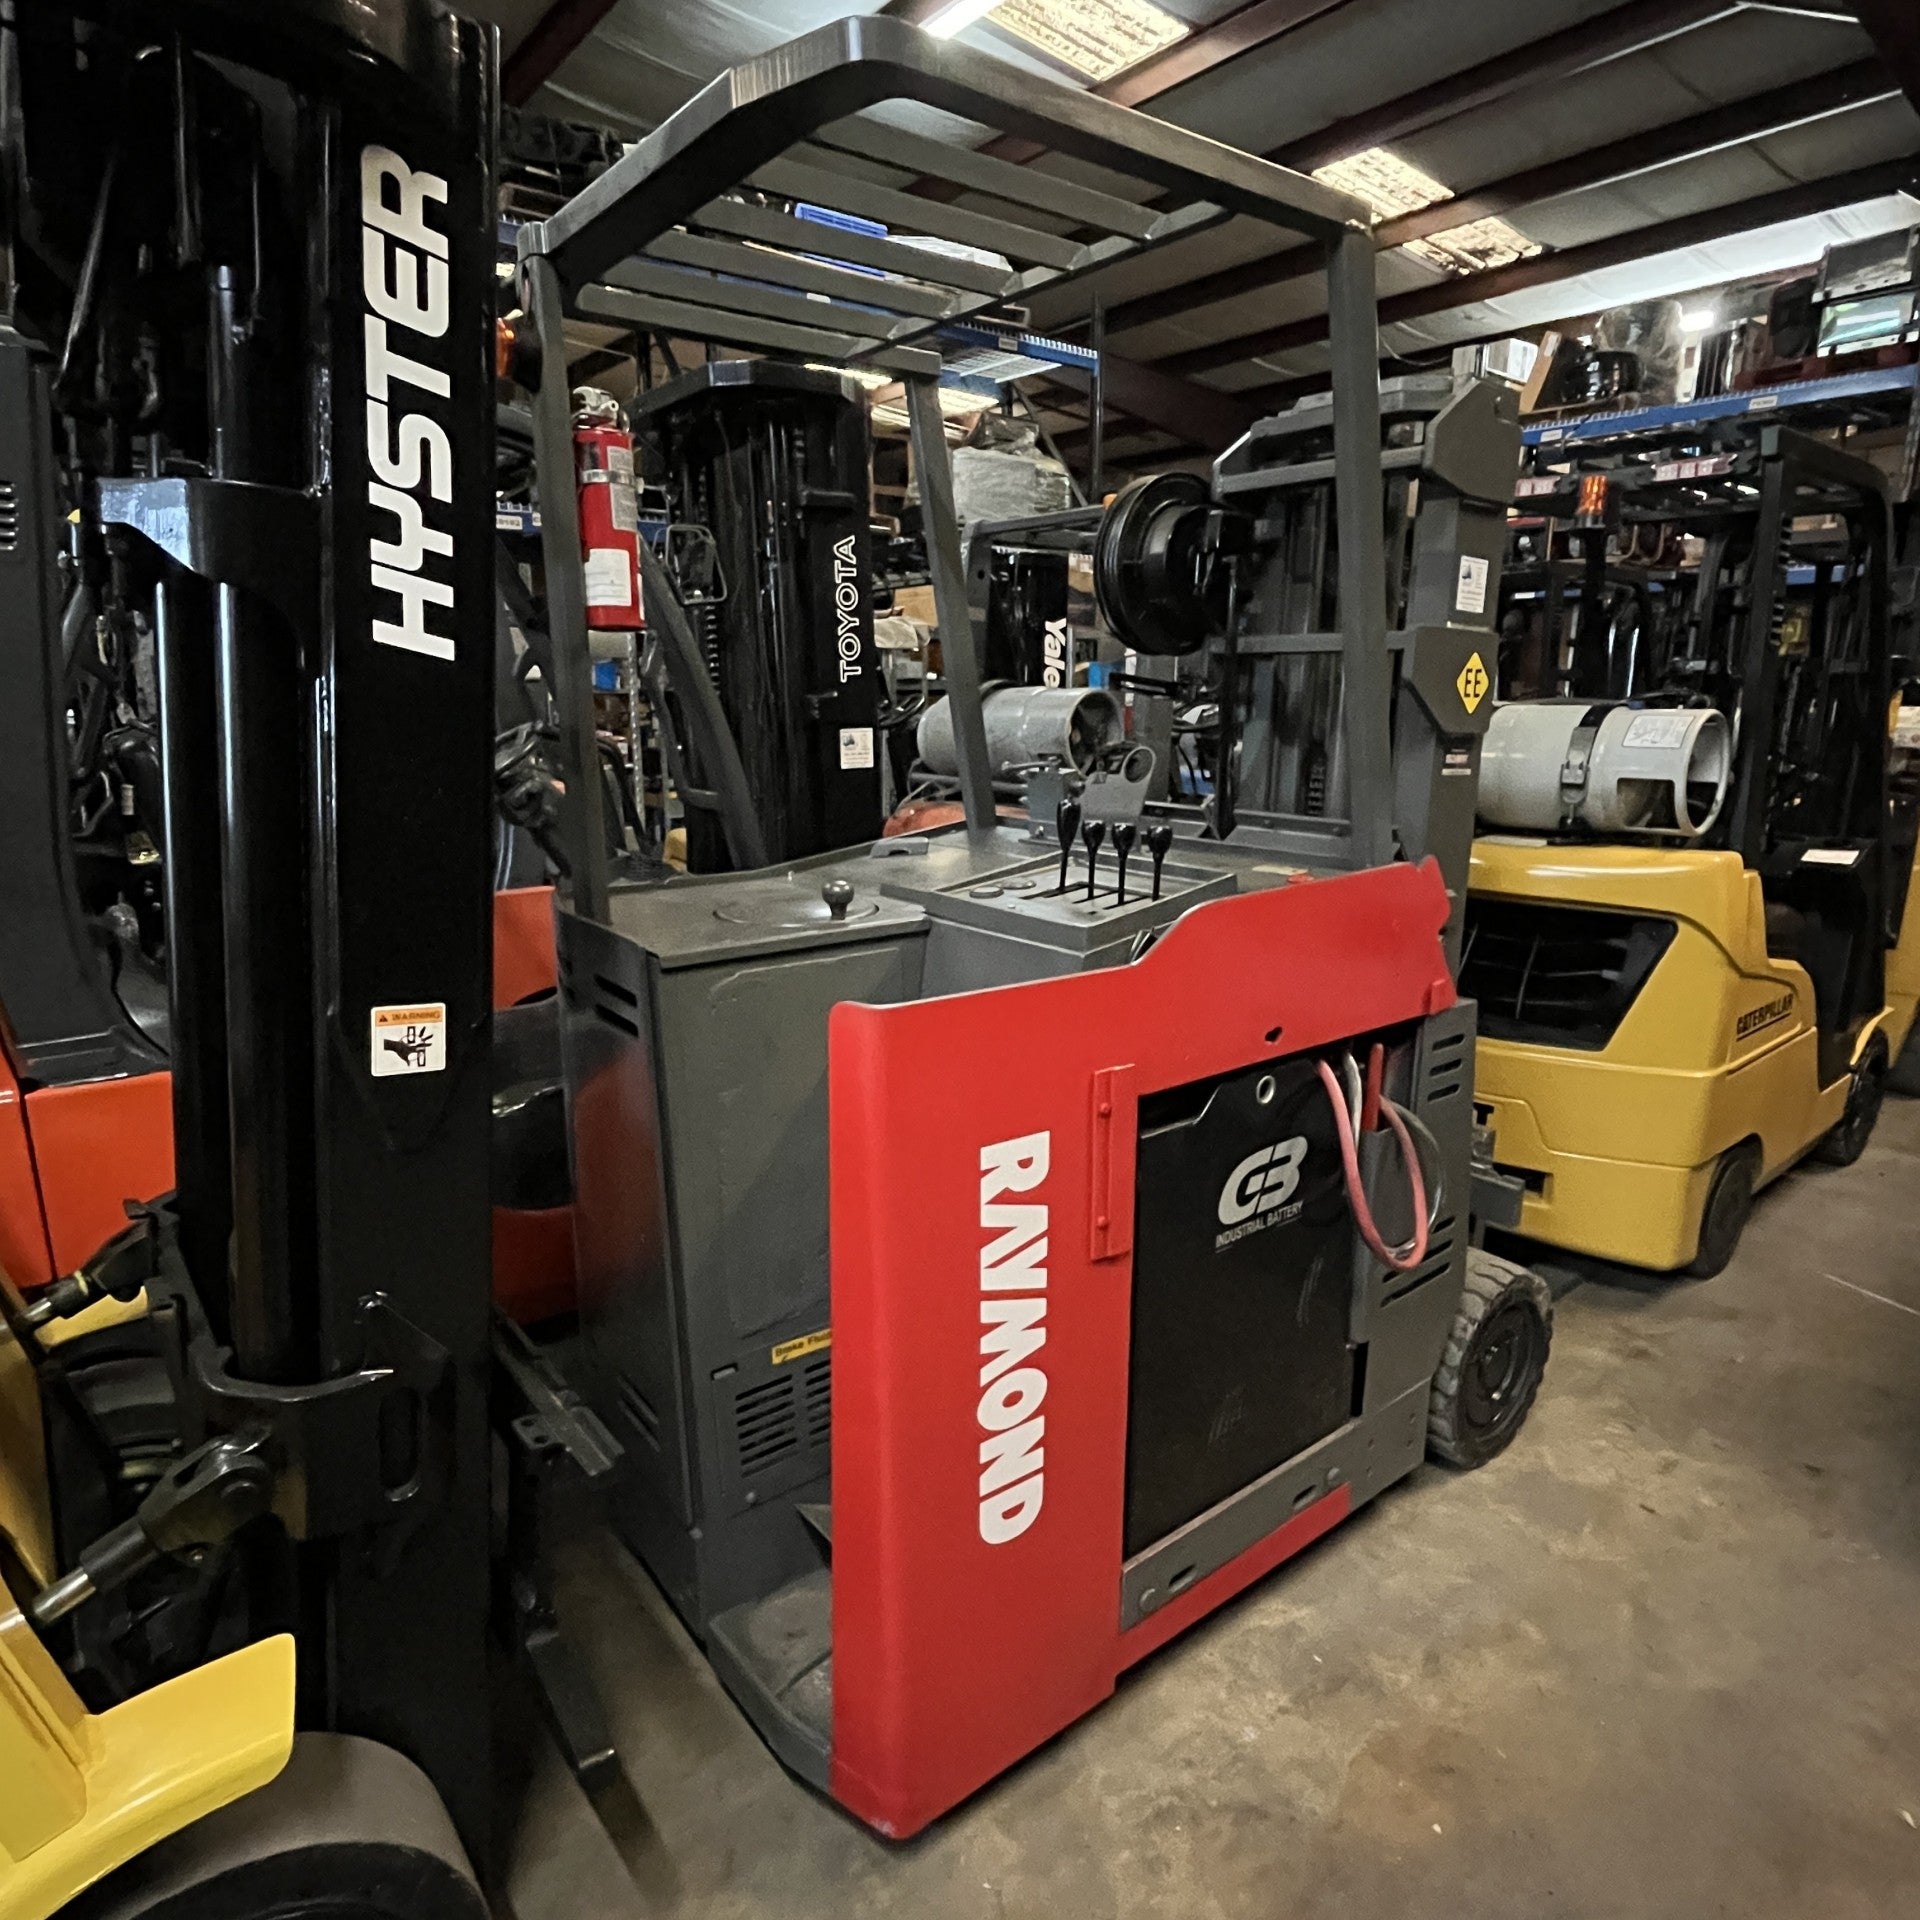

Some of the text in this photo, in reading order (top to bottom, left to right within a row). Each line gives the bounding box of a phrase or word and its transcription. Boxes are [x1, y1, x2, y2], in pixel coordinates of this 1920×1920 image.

[361, 146, 456, 662] HYSTER
[833, 535, 862, 683] TOYOTA
[1043, 617, 1067, 688] Yale
[1464, 668, 1482, 698] EE
[391, 1010, 441, 1021] WARNING
[1736, 993, 1793, 1035] CATERPILLAR
[1215, 1200, 1304, 1248] INDUSTRIAL BATTERY
[977, 1130, 1051, 1545] RAYMOND
